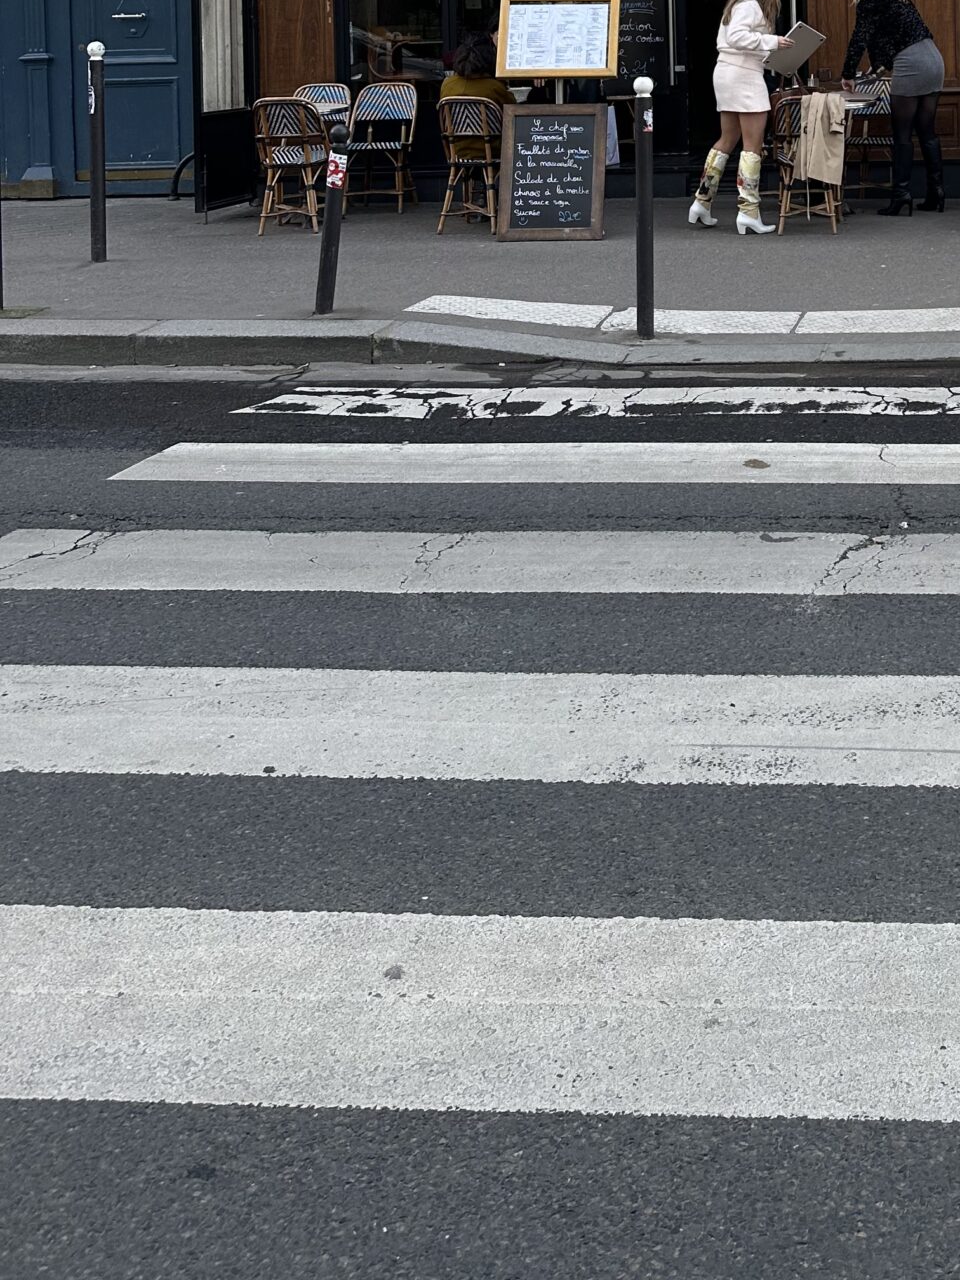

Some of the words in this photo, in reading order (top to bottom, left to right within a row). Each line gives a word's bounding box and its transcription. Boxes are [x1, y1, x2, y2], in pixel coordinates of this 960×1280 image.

[554, 144, 565, 154] de
[514, 170, 544, 185] Salade
[546, 173, 559, 183] de
